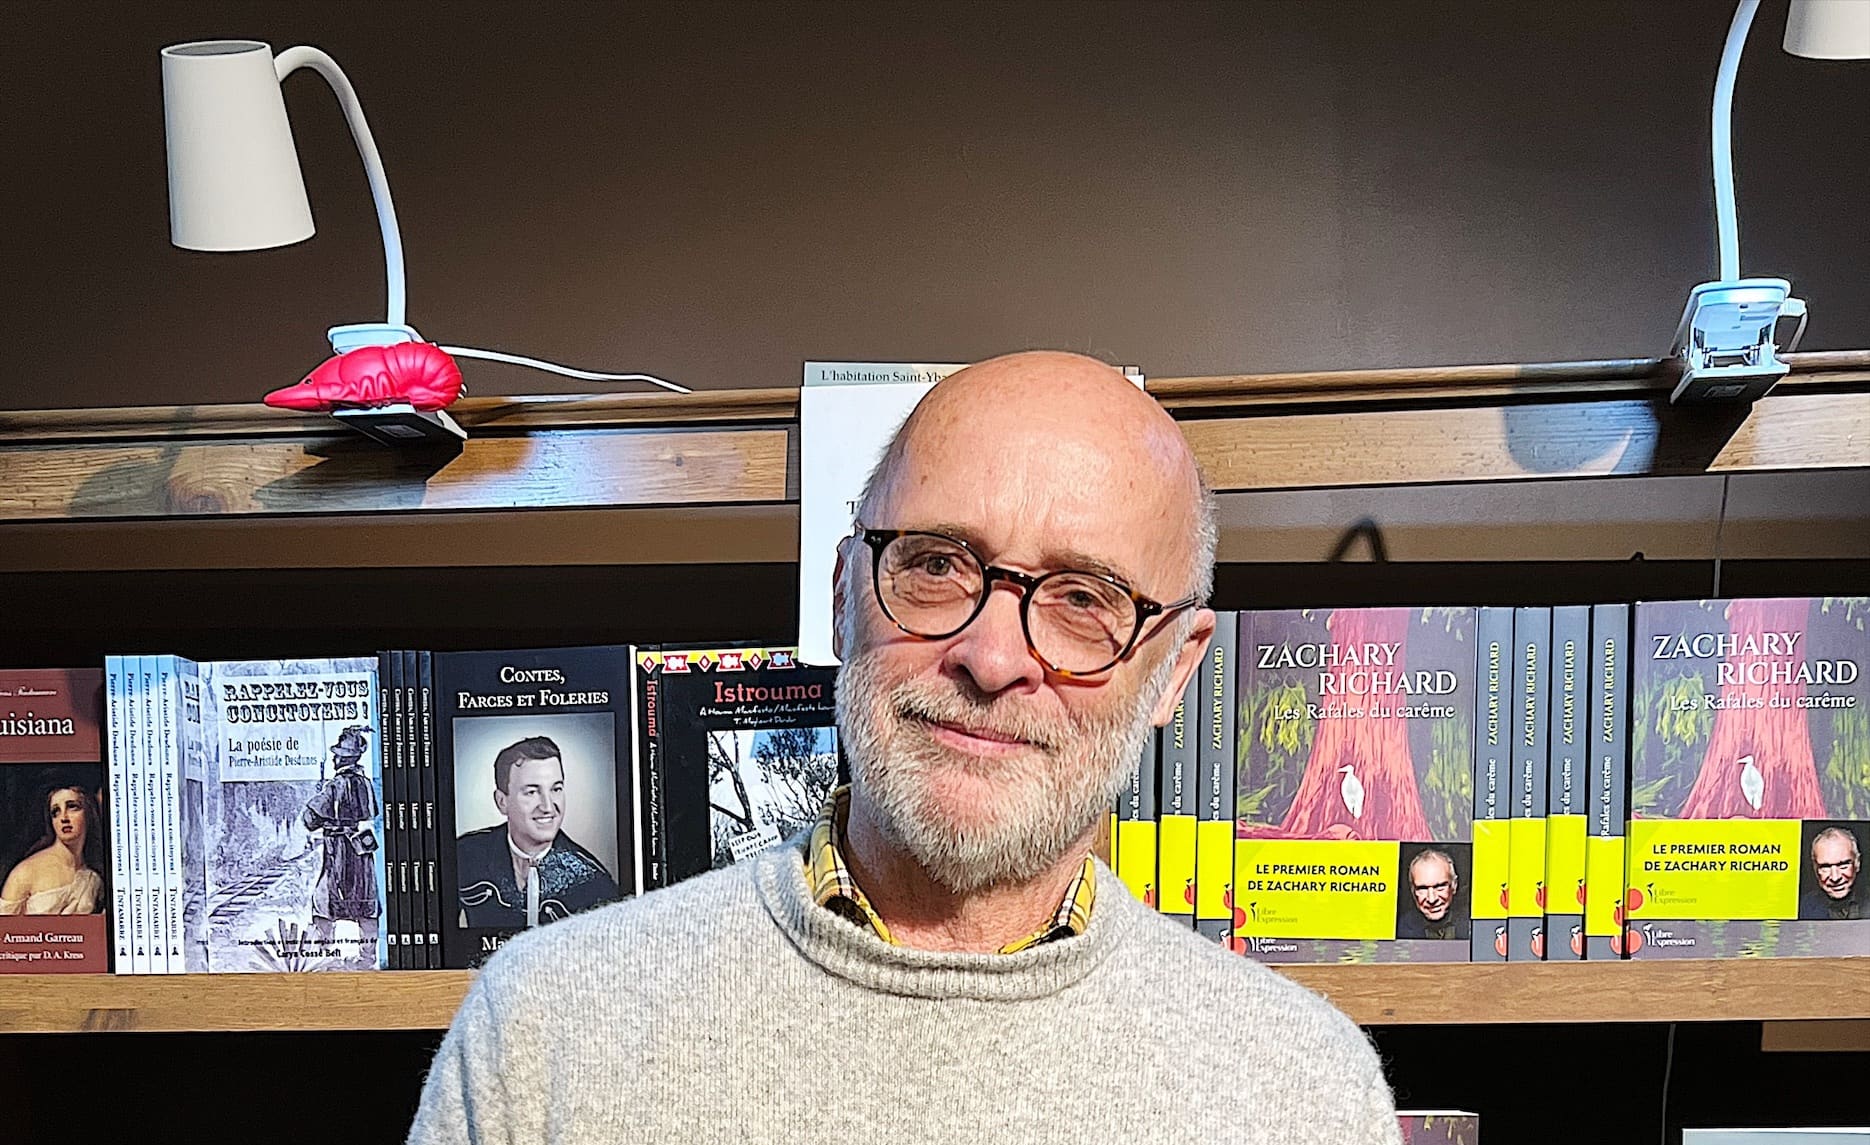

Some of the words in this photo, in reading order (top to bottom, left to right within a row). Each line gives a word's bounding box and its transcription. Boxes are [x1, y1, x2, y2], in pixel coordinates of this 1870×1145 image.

[821, 369, 890, 382] L'habitation
[892, 370, 948, 382] Saint-Yba
[1256, 642, 1401, 669] ZACHARY
[1652, 632, 1802, 660] ZACHARY
[1213, 646, 1224, 697] RICHARD
[1488, 641, 1499, 692] RICHARD
[1526, 643, 1536, 694] RICHARD
[1564, 640, 1575, 692] RICHARD
[1604, 638, 1615, 690] RICHARD
[1716, 659, 1859, 686] RICHARD
[223, 680, 370, 702] RAPPELEZ-VOUS
[713, 681, 823, 703] Istrouma
[1317, 670, 1458, 696] RICHARD
[226, 701, 358, 723] CONCITOYENS
[646, 679, 658, 737] Istrouma
[1273, 703, 1300, 720] Les
[1306, 702, 1364, 720] Rafales
[1369, 701, 1391, 719] du
[1395, 701, 1456, 719] carême
[1670, 694, 1698, 711] Les
[1703, 693, 1764, 710] Rafales
[1768, 692, 1791, 709] du
[1795, 691, 1856, 709] carême
[0, 711, 75, 736] uisiana
[1213, 699, 1223, 750] ZACHARY
[1487, 694, 1498, 745] ZACHARY
[1524, 696, 1535, 747] ZACHARY
[1563, 693, 1574, 745] ZACHARY
[1603, 691, 1614, 743] ZACHARY
[228, 738, 242, 752] La
[247, 736, 284, 754] poésie
[286, 737, 299, 751] de
[228, 754, 283, 767] Pierre-Aristide
[1601, 756, 1611, 789] carême
[1172, 761, 1183, 794] carême
[1210, 762, 1221, 795] carême
[1487, 758, 1497, 792] carême
[1523, 760, 1533, 793] carême
[1561, 758, 1572, 791] carême
[1129, 795, 1140, 808] du
[1171, 795, 1182, 809] du
[1209, 796, 1220, 810] du
[1485, 792, 1496, 806] du
[1521, 794, 1532, 807] du
[1560, 792, 1571, 805] du
[1600, 790, 1610, 804] du
[1653, 844, 1667, 854] LE
[1670, 844, 1726, 854] PREMIER
[1729, 844, 1781, 854] ROMAN
[1256, 864, 1270, 874] LE
[1272, 864, 1326, 875] PREMIER
[1329, 865, 1380, 876] ROMAN
[1644, 861, 1661, 871] DE
[1664, 861, 1727, 871] ZACHARY
[1730, 861, 1789, 871] RICHARD
[1247, 880, 1263, 891] DE
[1266, 880, 1327, 891] ZACHARY
[1329, 881, 1387, 892] RICHARD
[1654, 896, 1697, 905] Expression
[3, 933, 43, 943] Armand
[44, 933, 84, 943] Garreau
